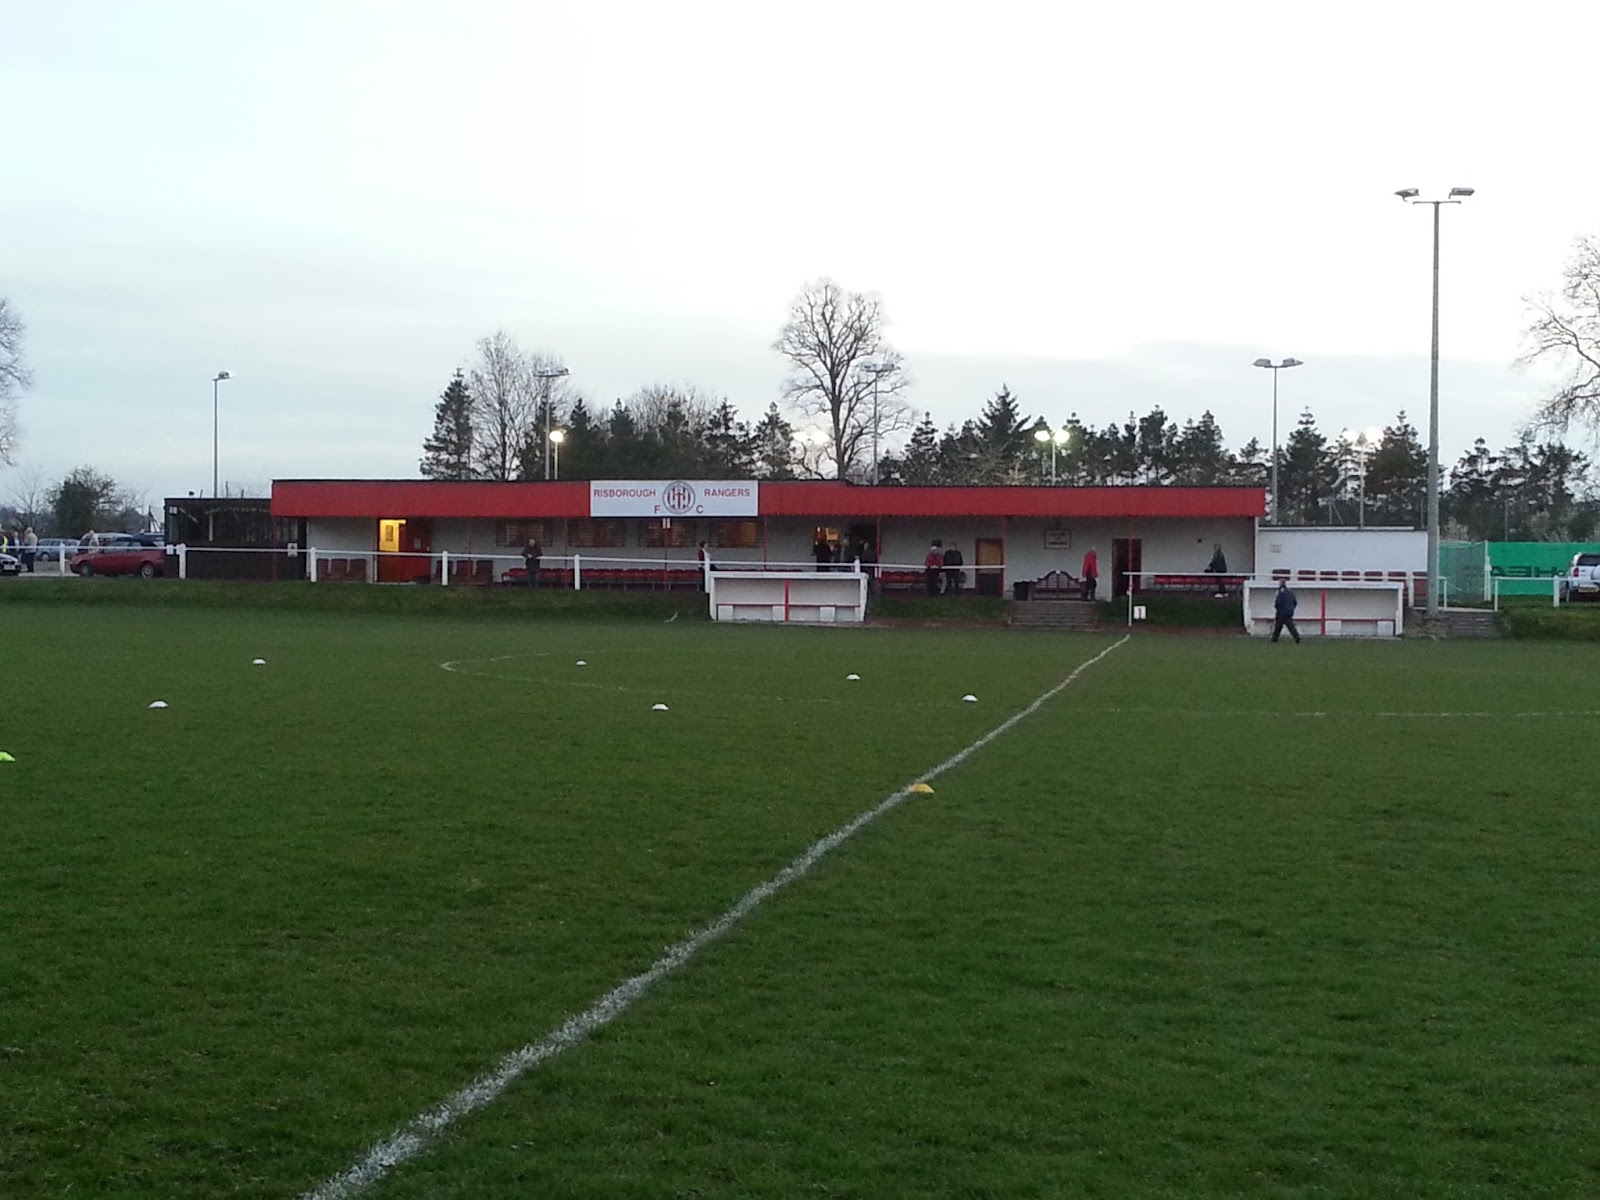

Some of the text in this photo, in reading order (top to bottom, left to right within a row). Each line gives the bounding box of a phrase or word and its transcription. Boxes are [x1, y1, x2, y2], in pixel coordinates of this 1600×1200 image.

[593, 488, 750, 498] RISBOROUGH RANGERS
[653, 505, 704, 514] F C
